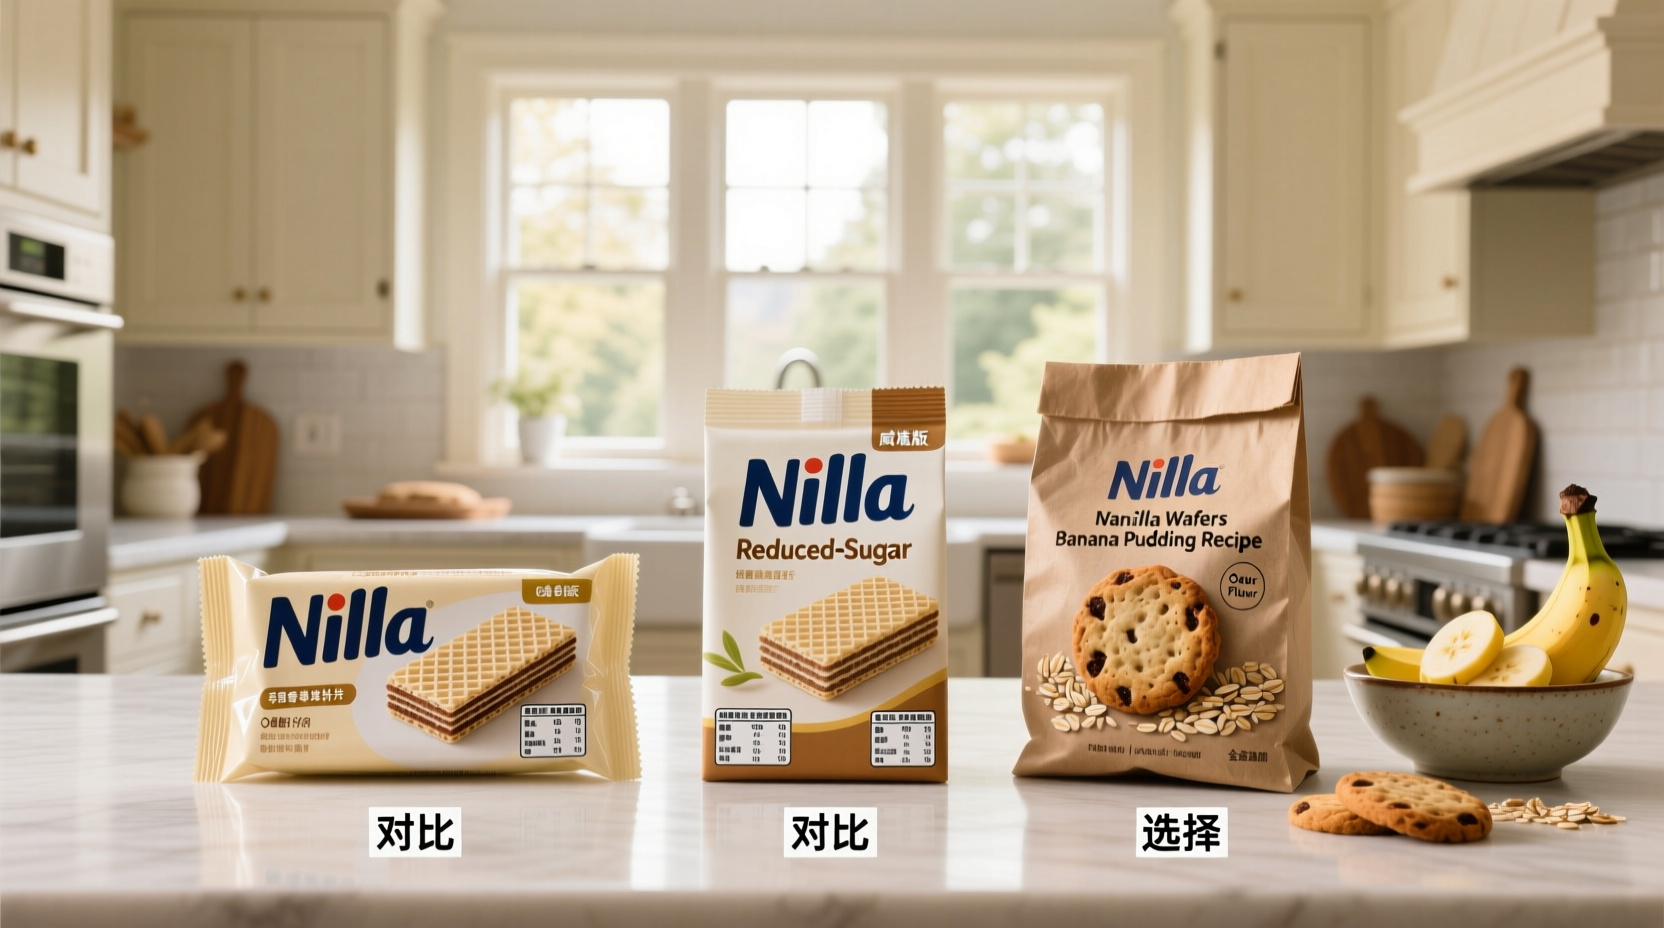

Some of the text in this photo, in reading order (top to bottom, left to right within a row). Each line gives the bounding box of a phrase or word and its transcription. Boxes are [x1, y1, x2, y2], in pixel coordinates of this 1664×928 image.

[739, 453, 915, 527] Nilla
[1107, 454, 1221, 500] Nilla
[1165, 510, 1228, 527] Wafers
[736, 537, 913, 566] Reduced-Sugar
[1055, 530, 1263, 553] Banana Pudding Recipe
[263, 586, 435, 669] Nilla
